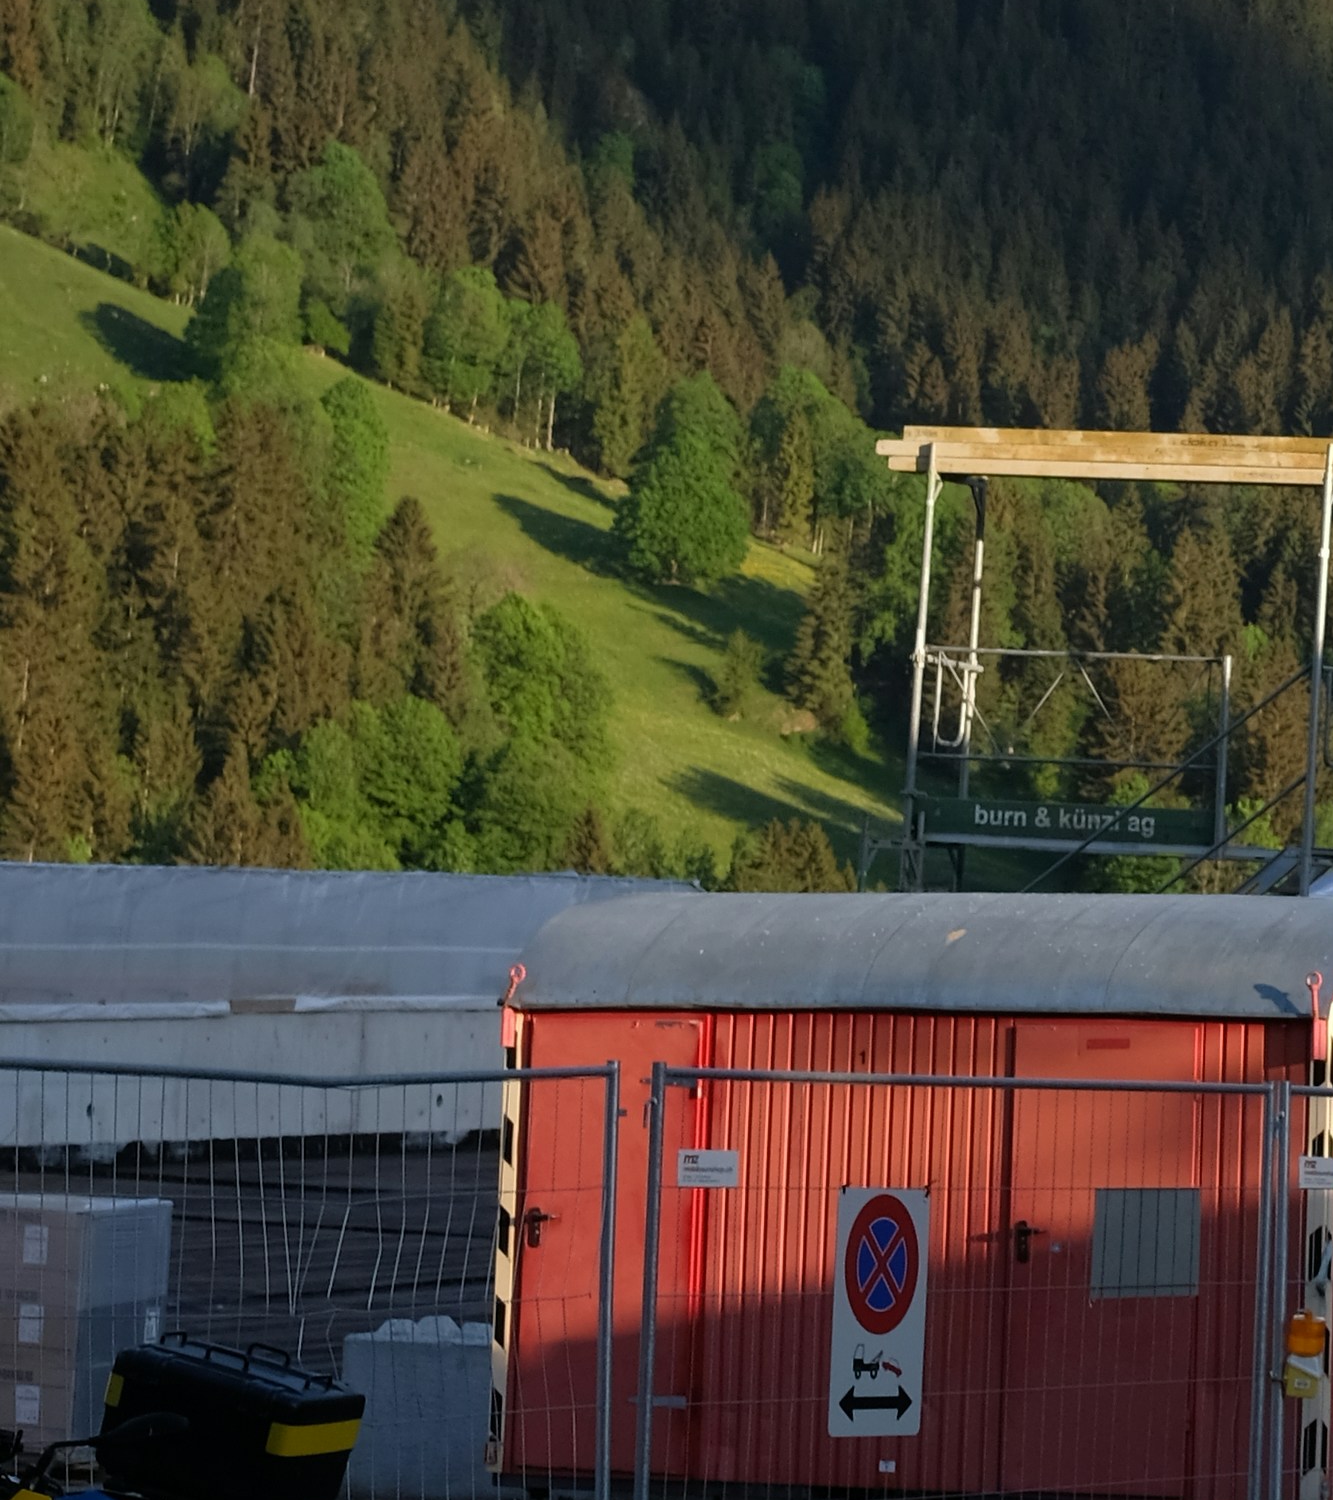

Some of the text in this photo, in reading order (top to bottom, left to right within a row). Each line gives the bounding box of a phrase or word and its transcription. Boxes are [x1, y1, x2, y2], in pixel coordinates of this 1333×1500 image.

[974, 804, 1027, 827] burn
[1034, 806, 1051, 828] &
[1127, 816, 1155, 838] ag
